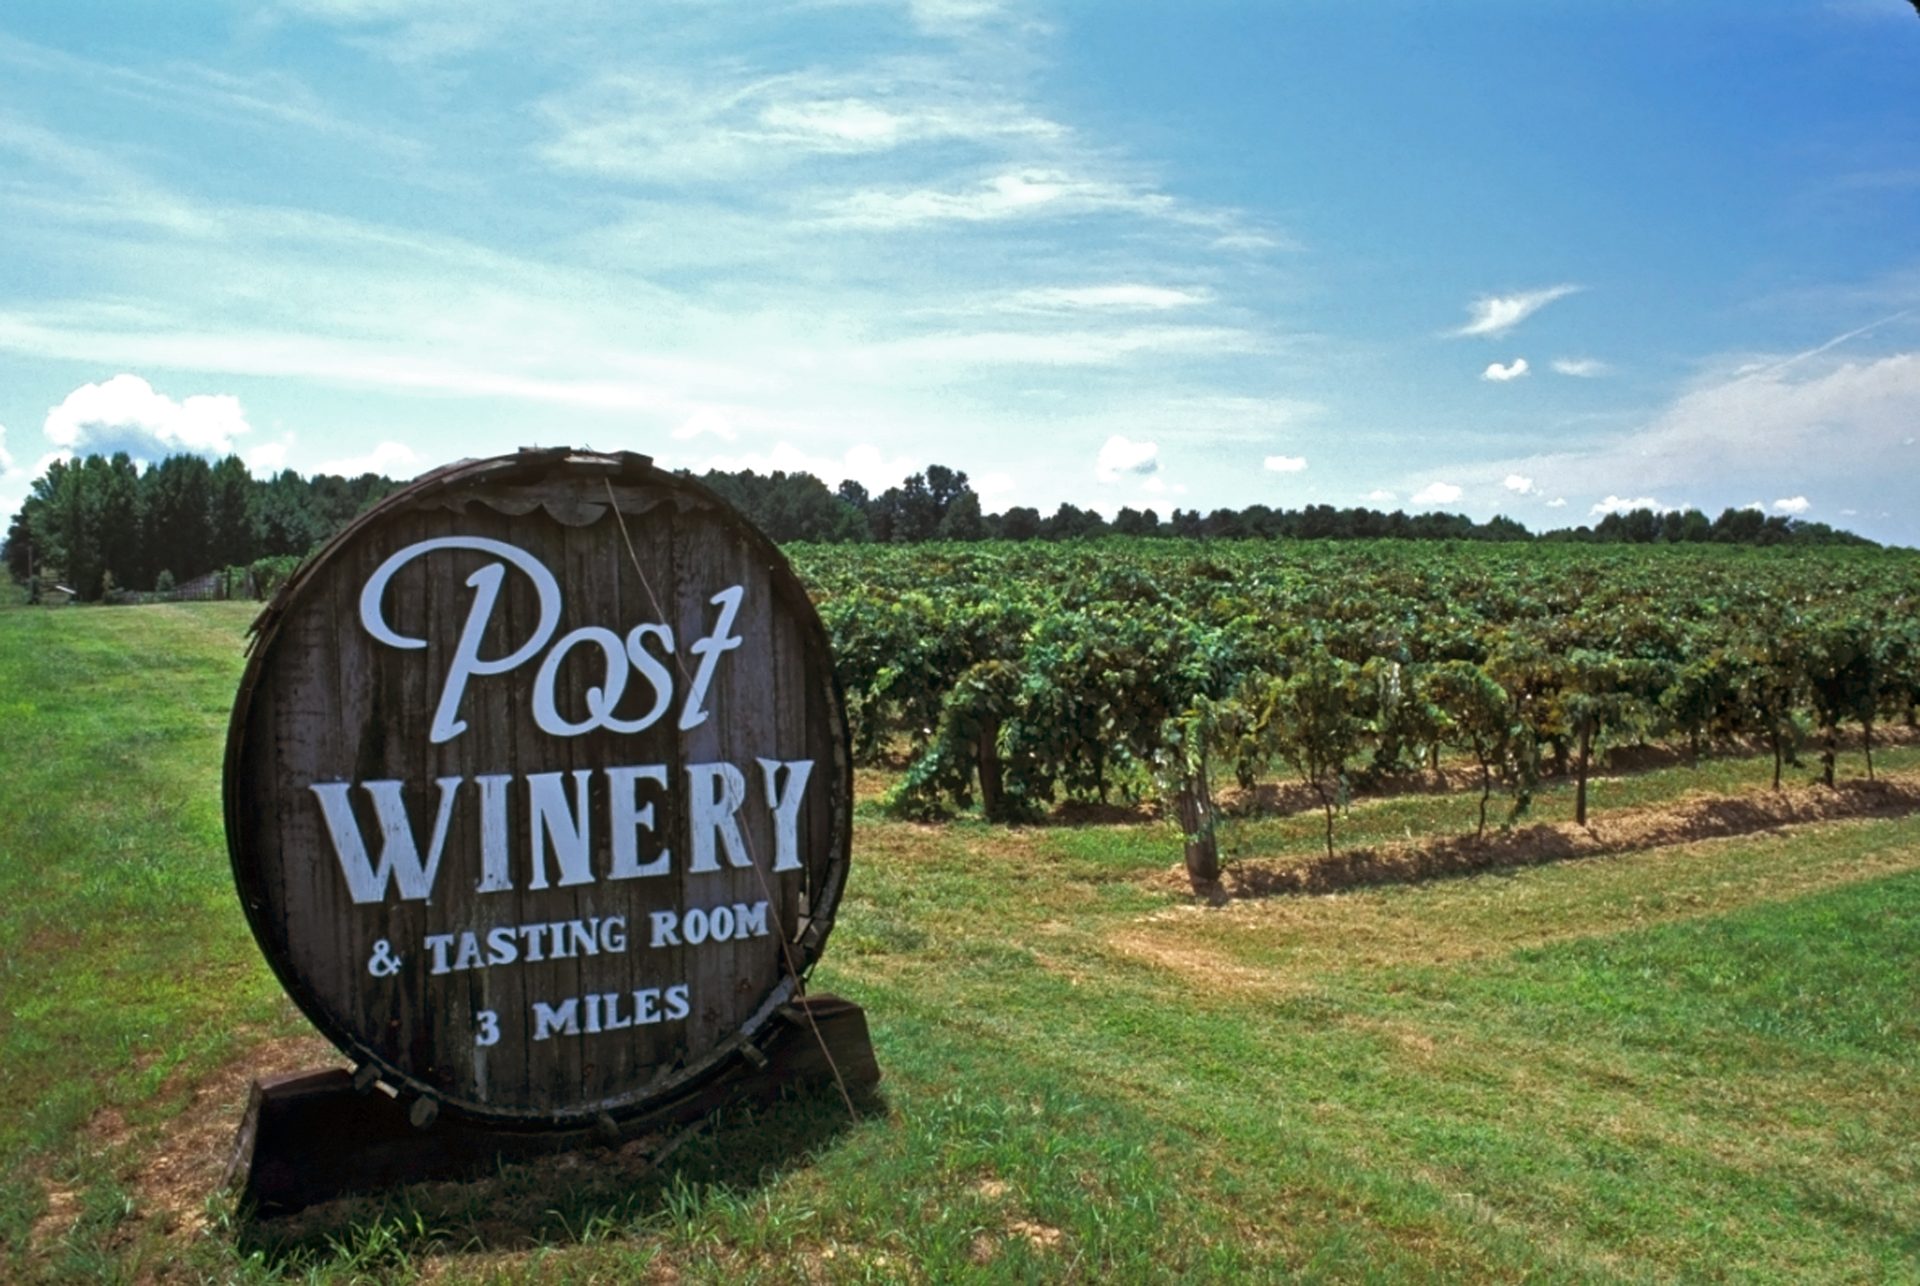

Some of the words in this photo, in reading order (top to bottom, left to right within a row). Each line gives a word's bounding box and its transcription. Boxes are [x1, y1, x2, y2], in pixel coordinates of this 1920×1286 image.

[360, 536, 744, 743] Post
[309, 757, 815, 905] WINERY
[368, 938, 402, 978] &
[424, 916, 627, 975] TASTING
[649, 901, 770, 948] ROOM
[476, 1010, 500, 1047] 3
[532, 984, 691, 1041] MILES
